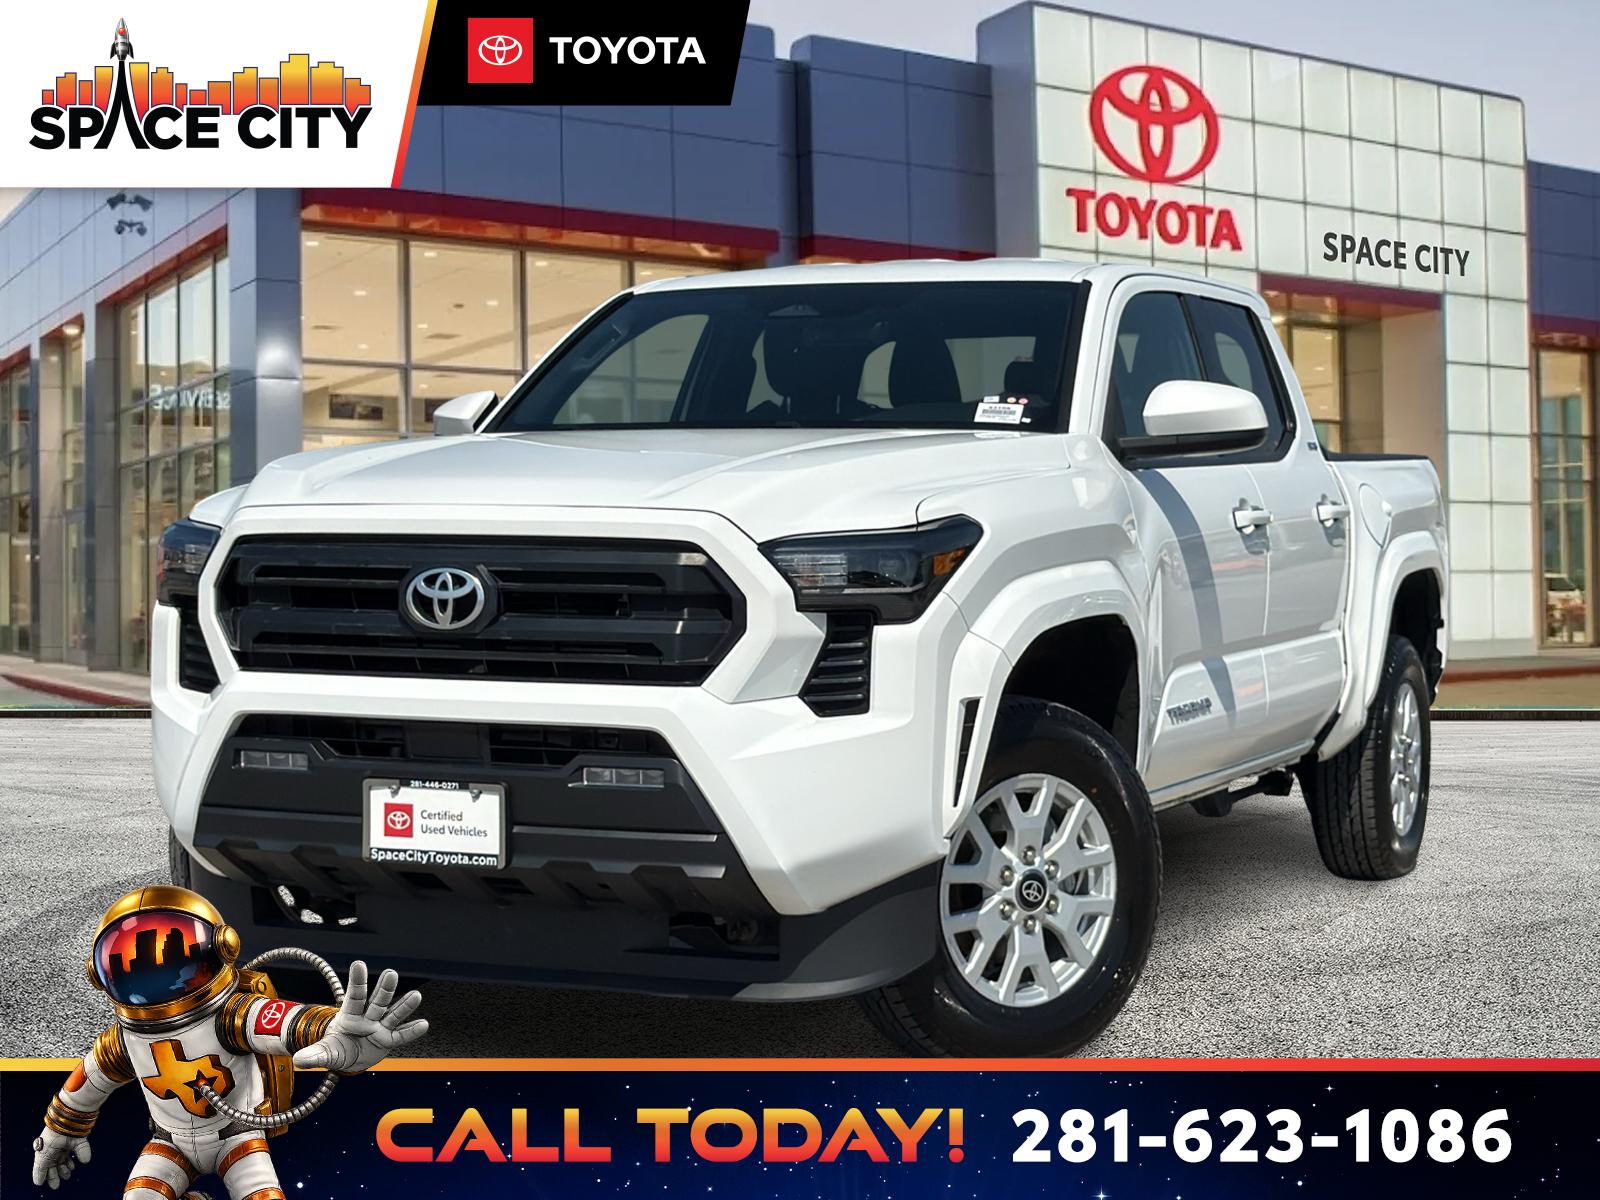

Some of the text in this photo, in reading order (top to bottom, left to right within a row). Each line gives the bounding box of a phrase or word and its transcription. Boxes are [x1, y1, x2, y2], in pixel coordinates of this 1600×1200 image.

[1066, 188, 1242, 251] TOYOTA
[1323, 232, 1470, 277] SPACE CITY
[409, 780, 460, 790] 281-446-0271
[420, 809, 463, 822] Certified
[420, 824, 488, 838] Used Vehicles
[370, 848, 498, 866] SpaceCityToyota.com
